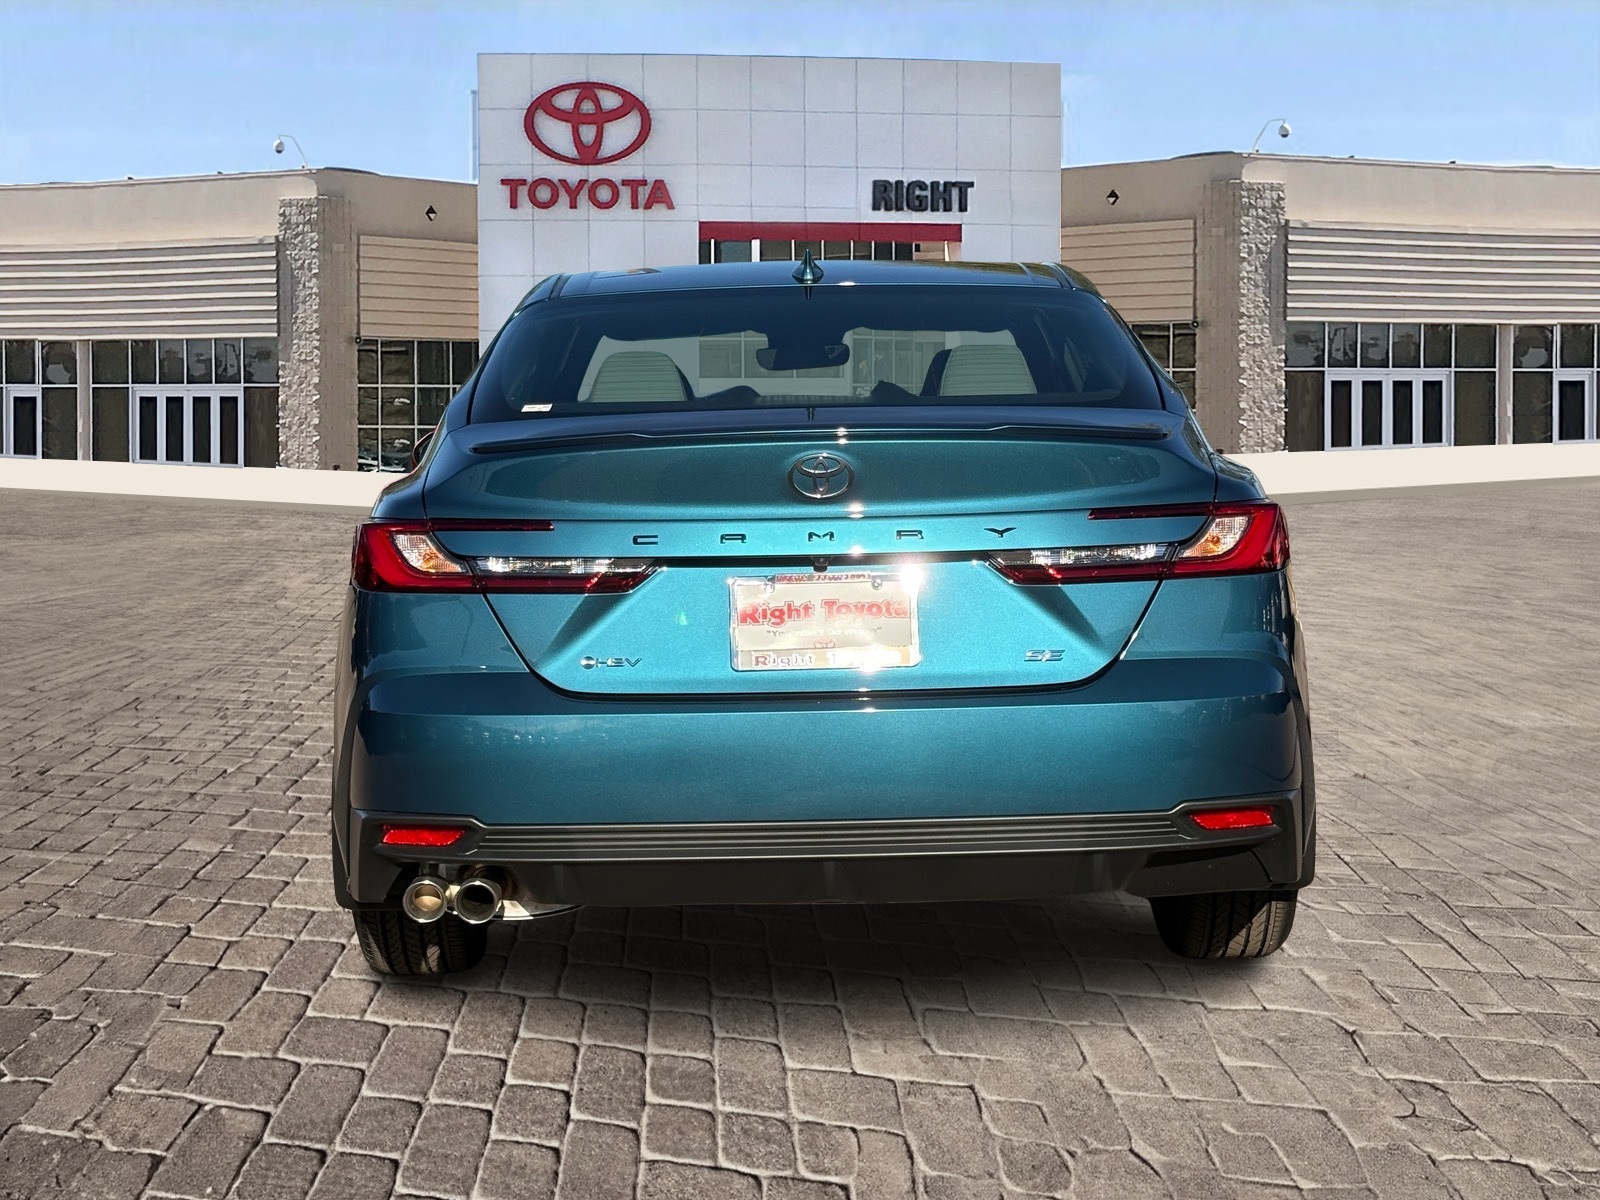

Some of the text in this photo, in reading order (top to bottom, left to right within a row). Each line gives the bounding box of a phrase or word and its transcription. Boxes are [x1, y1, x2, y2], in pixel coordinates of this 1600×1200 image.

[500, 178, 675, 211] TOYOTA
[872, 179, 975, 213] RIGHT
[632, 527, 1017, 546] CAMRY
[738, 598, 911, 628] Right Toyota
[595, 657, 642, 668] HEV
[753, 653, 814, 668] Right
[1023, 649, 1066, 662] SE
